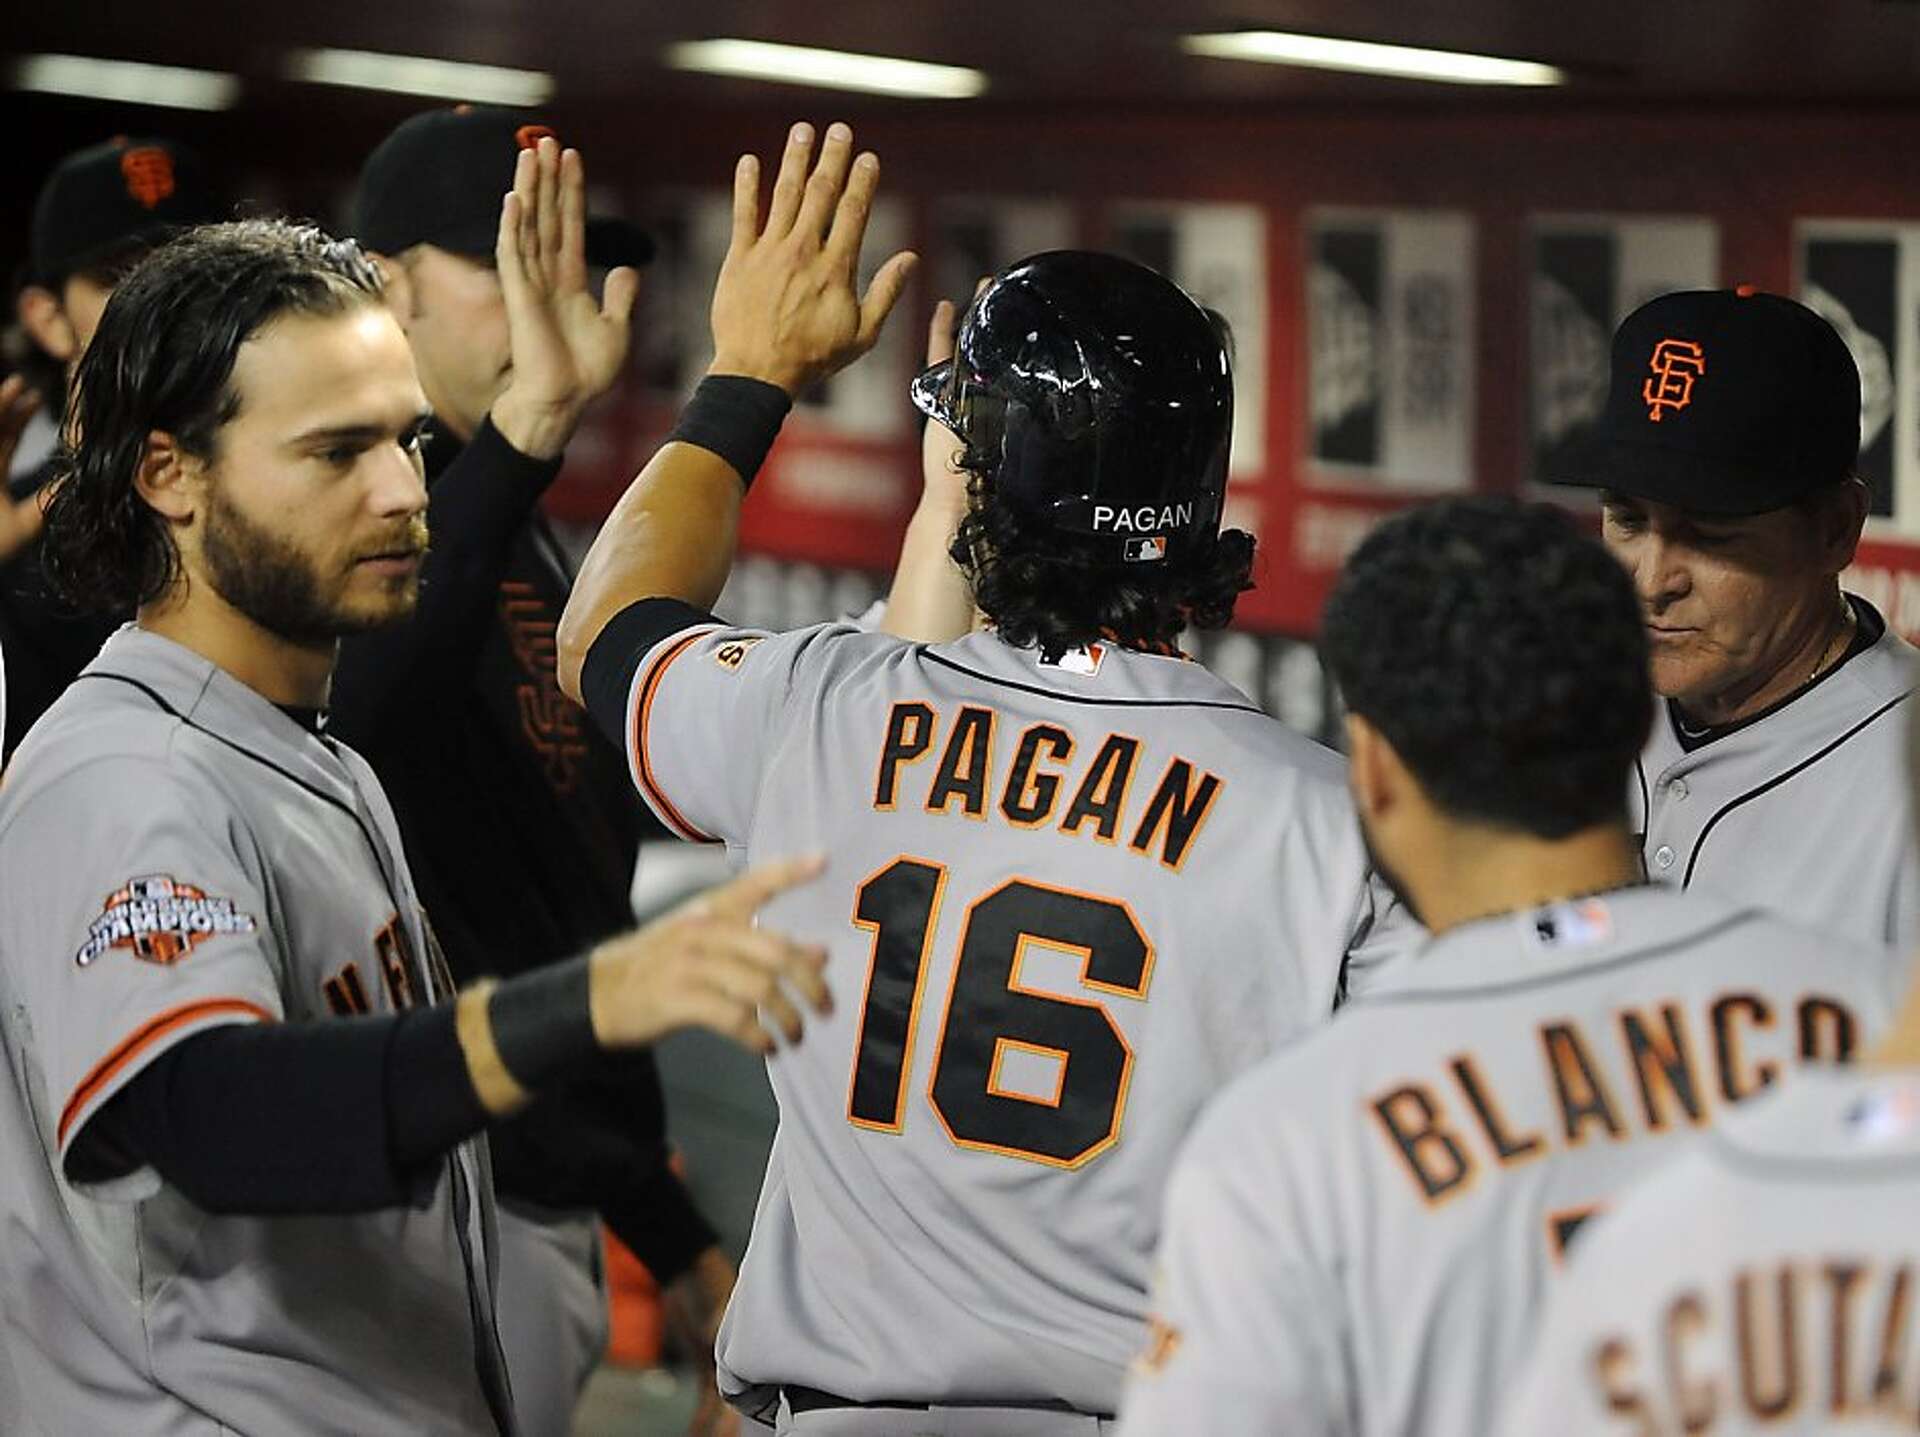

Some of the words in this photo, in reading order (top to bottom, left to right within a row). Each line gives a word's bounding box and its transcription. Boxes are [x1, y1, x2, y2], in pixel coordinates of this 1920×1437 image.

[1643, 339, 1705, 422] SF
[1092, 501, 1193, 532] PAGAN
[873, 700, 1226, 873] PAGAN
[847, 853, 1157, 1172] 16
